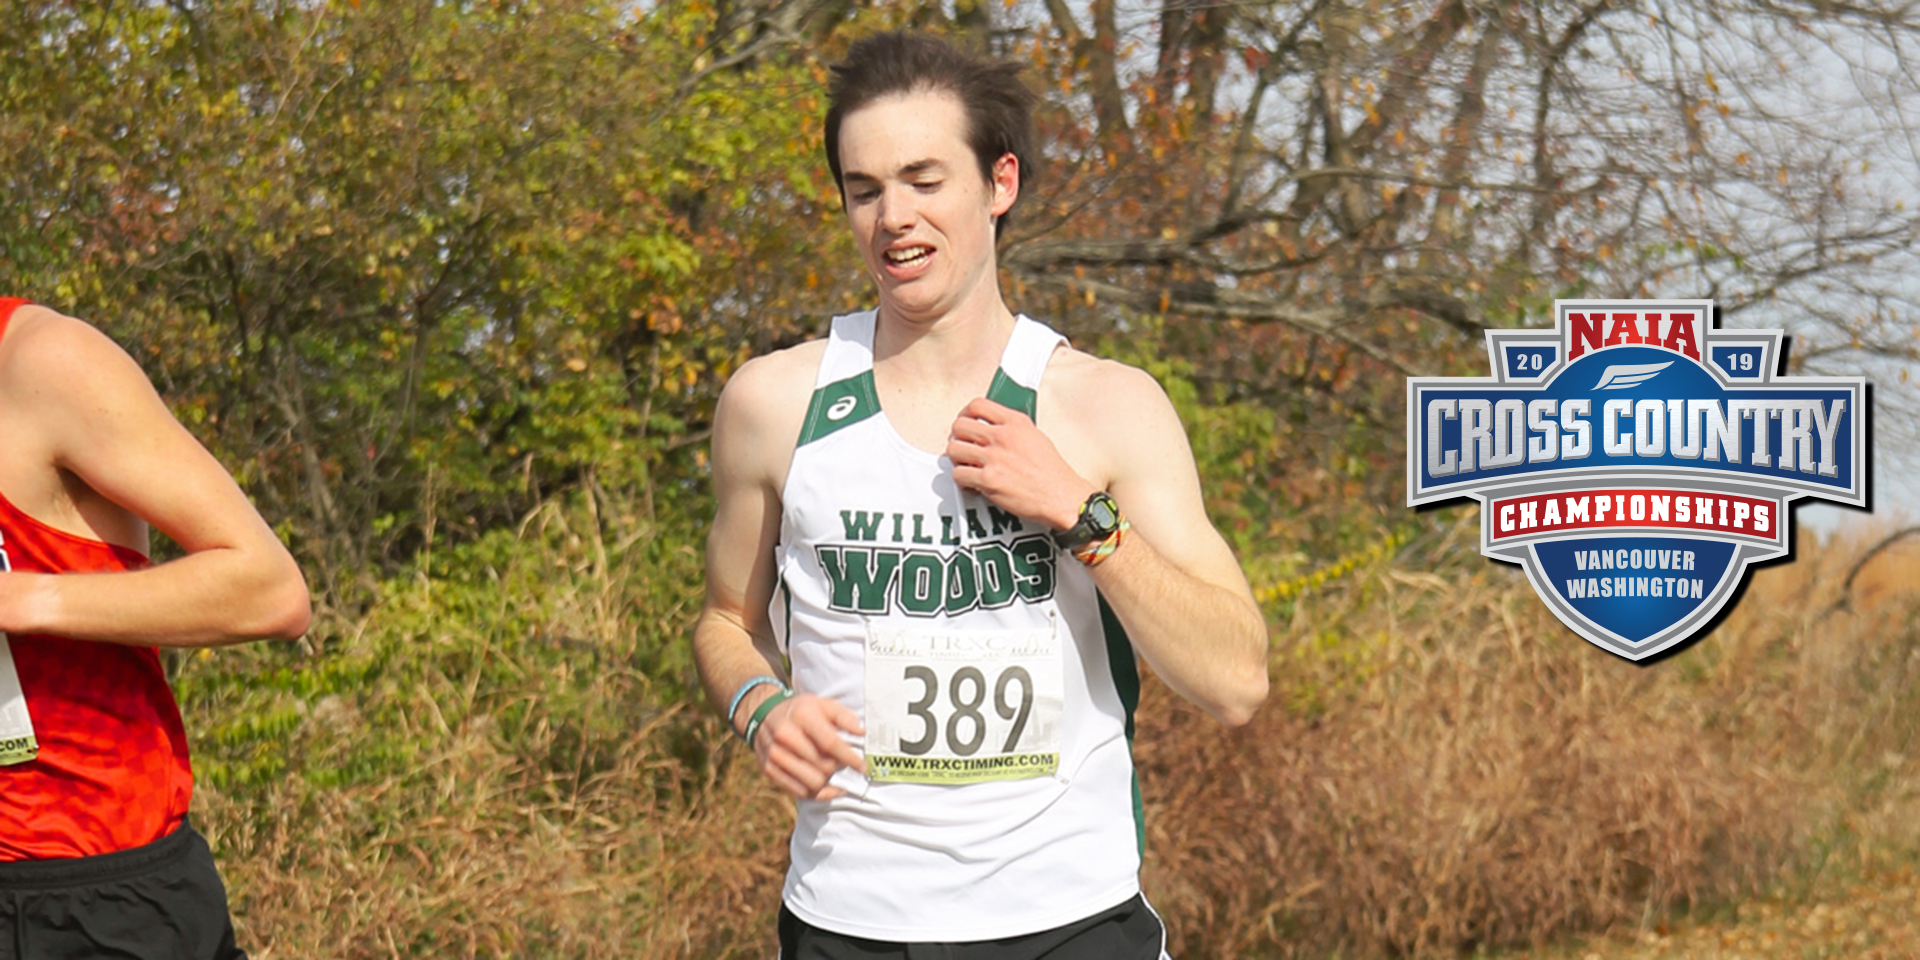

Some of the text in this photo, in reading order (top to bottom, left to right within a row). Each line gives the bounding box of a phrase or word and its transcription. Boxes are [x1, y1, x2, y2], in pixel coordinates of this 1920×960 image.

[839, 505, 1023, 546] WILLAM
[814, 533, 1057, 618] WOODS
[900, 665, 1034, 757] 389
[873, 754, 1054, 771] WWW.TRXCTIMING.COM
